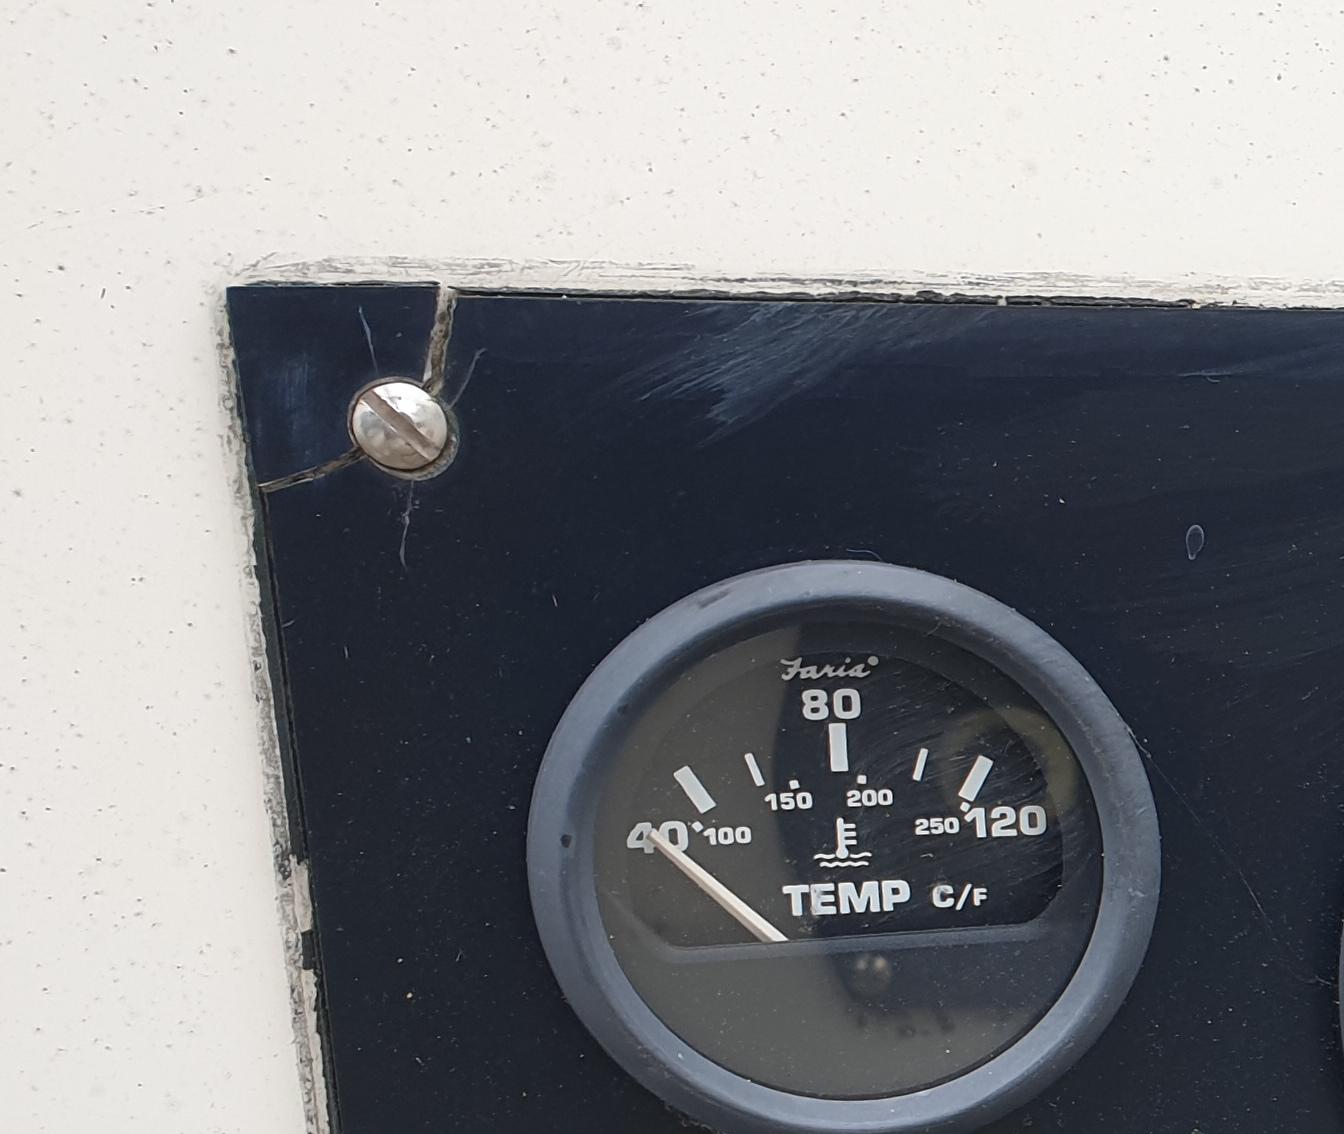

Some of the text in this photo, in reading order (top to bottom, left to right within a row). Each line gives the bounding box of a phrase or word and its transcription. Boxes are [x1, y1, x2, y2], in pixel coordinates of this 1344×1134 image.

[801, 688, 861, 721] 80
[764, 791, 813, 811] 150
[846, 788, 893, 808] 200
[914, 817, 960, 836] 250
[964, 804, 1047, 839] 120
[626, 820, 689, 854] 40
[702, 826, 752, 846] 100
[782, 879, 989, 916] TEMP C/F
